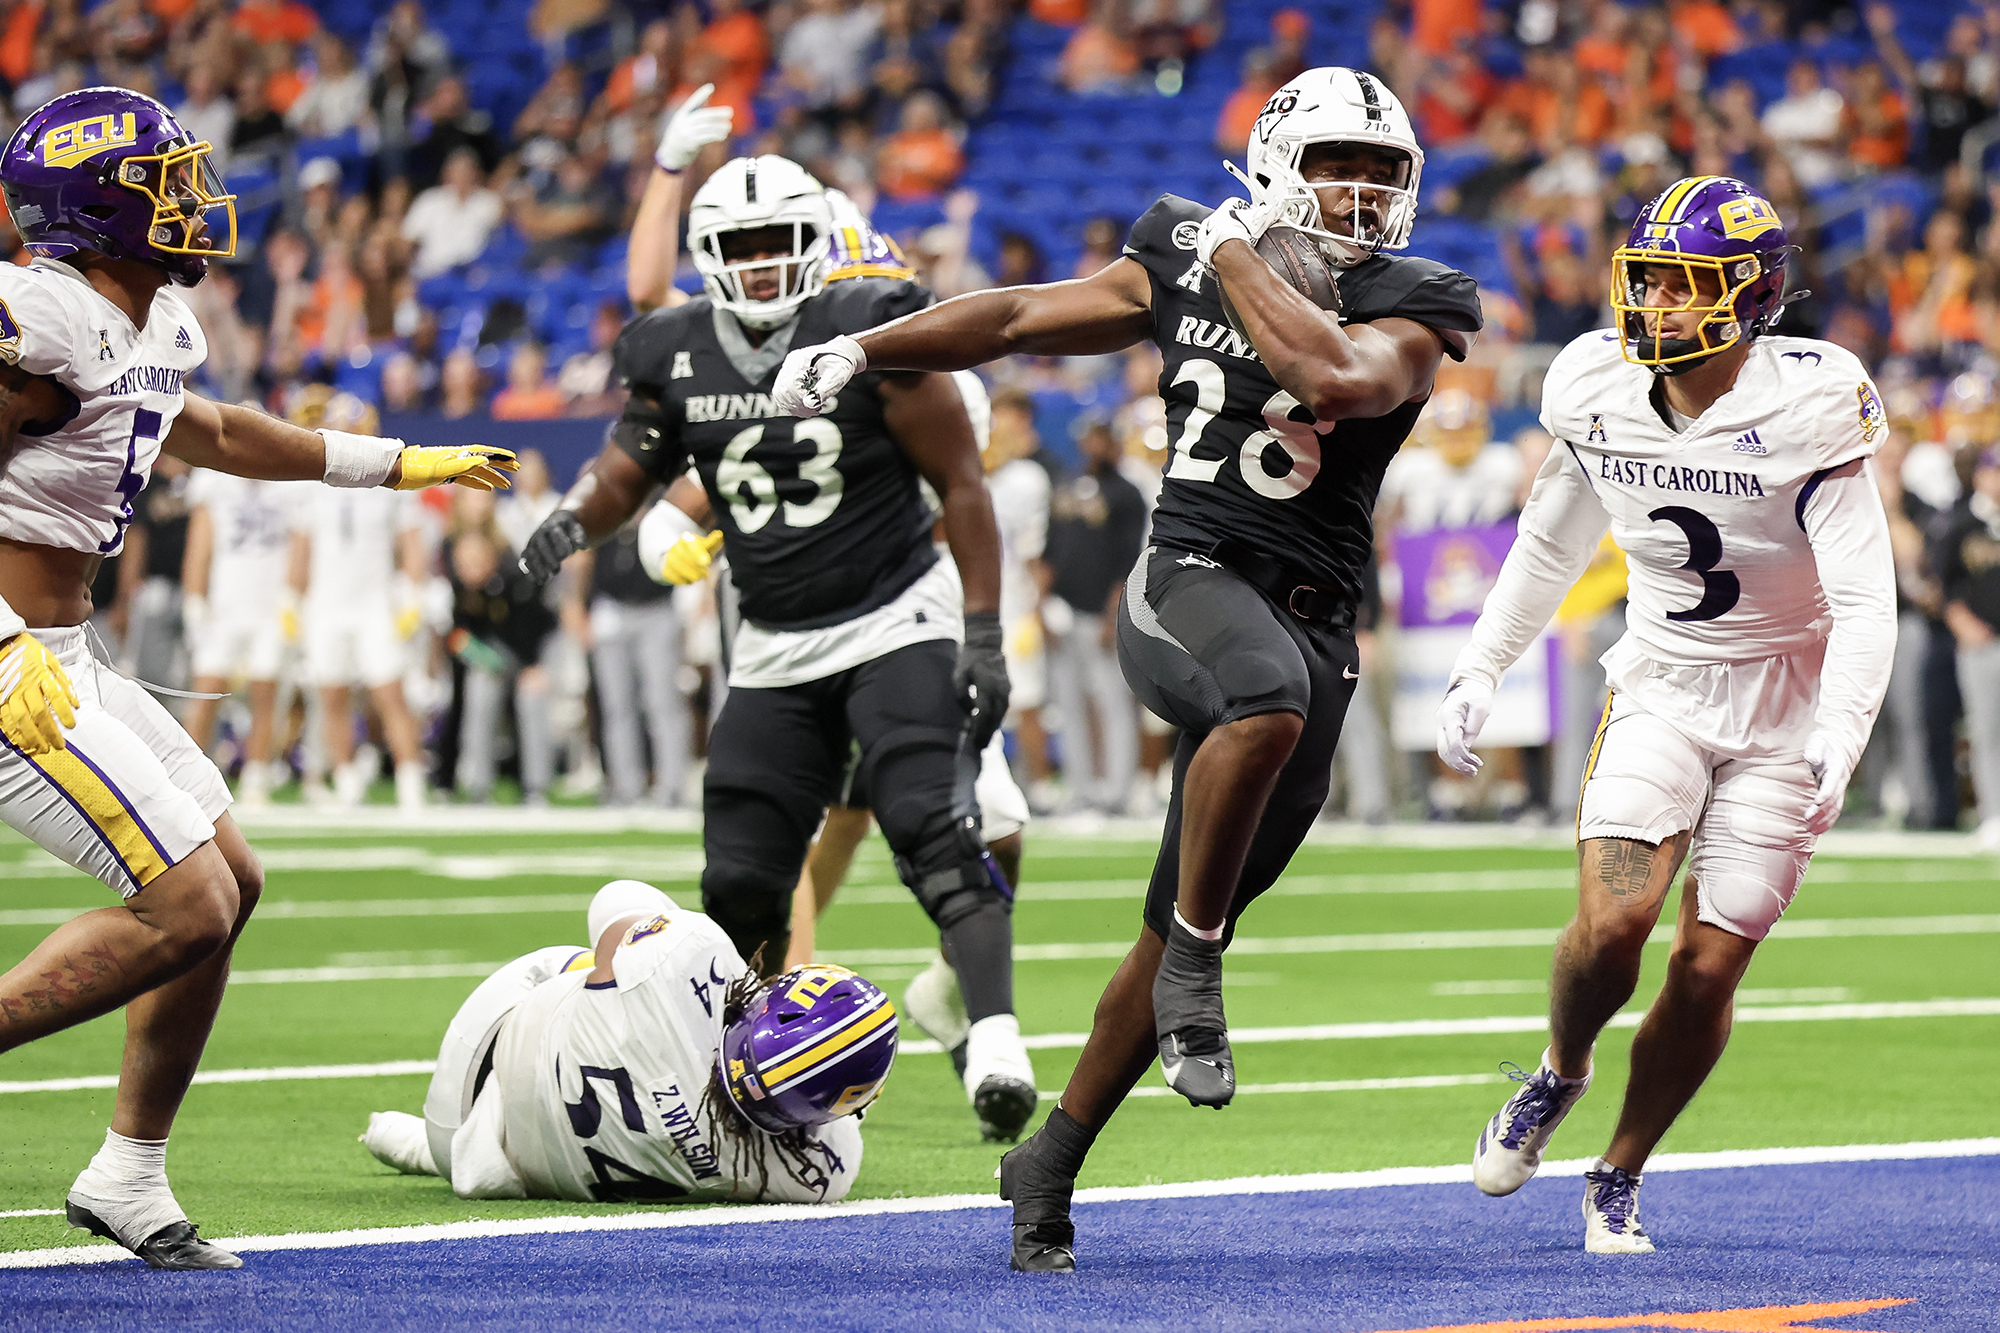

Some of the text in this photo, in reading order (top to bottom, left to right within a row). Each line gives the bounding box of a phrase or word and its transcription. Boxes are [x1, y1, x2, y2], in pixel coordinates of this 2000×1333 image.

[43, 111, 137, 165] ECU
[1362, 120, 1392, 133] 210
[109, 364, 187, 397] EAST CAROLIN
[684, 391, 840, 424] RUNNS
[1164, 357, 1337, 501] 28
[1731, 443, 1769, 455] adidas
[715, 416, 846, 535] 63
[1600, 453, 1767, 499] EAST CAROLINA
[1646, 505, 1742, 622] 3
[556, 1052, 692, 1204] 54
[651, 1083, 723, 1182] Z. WILSON
